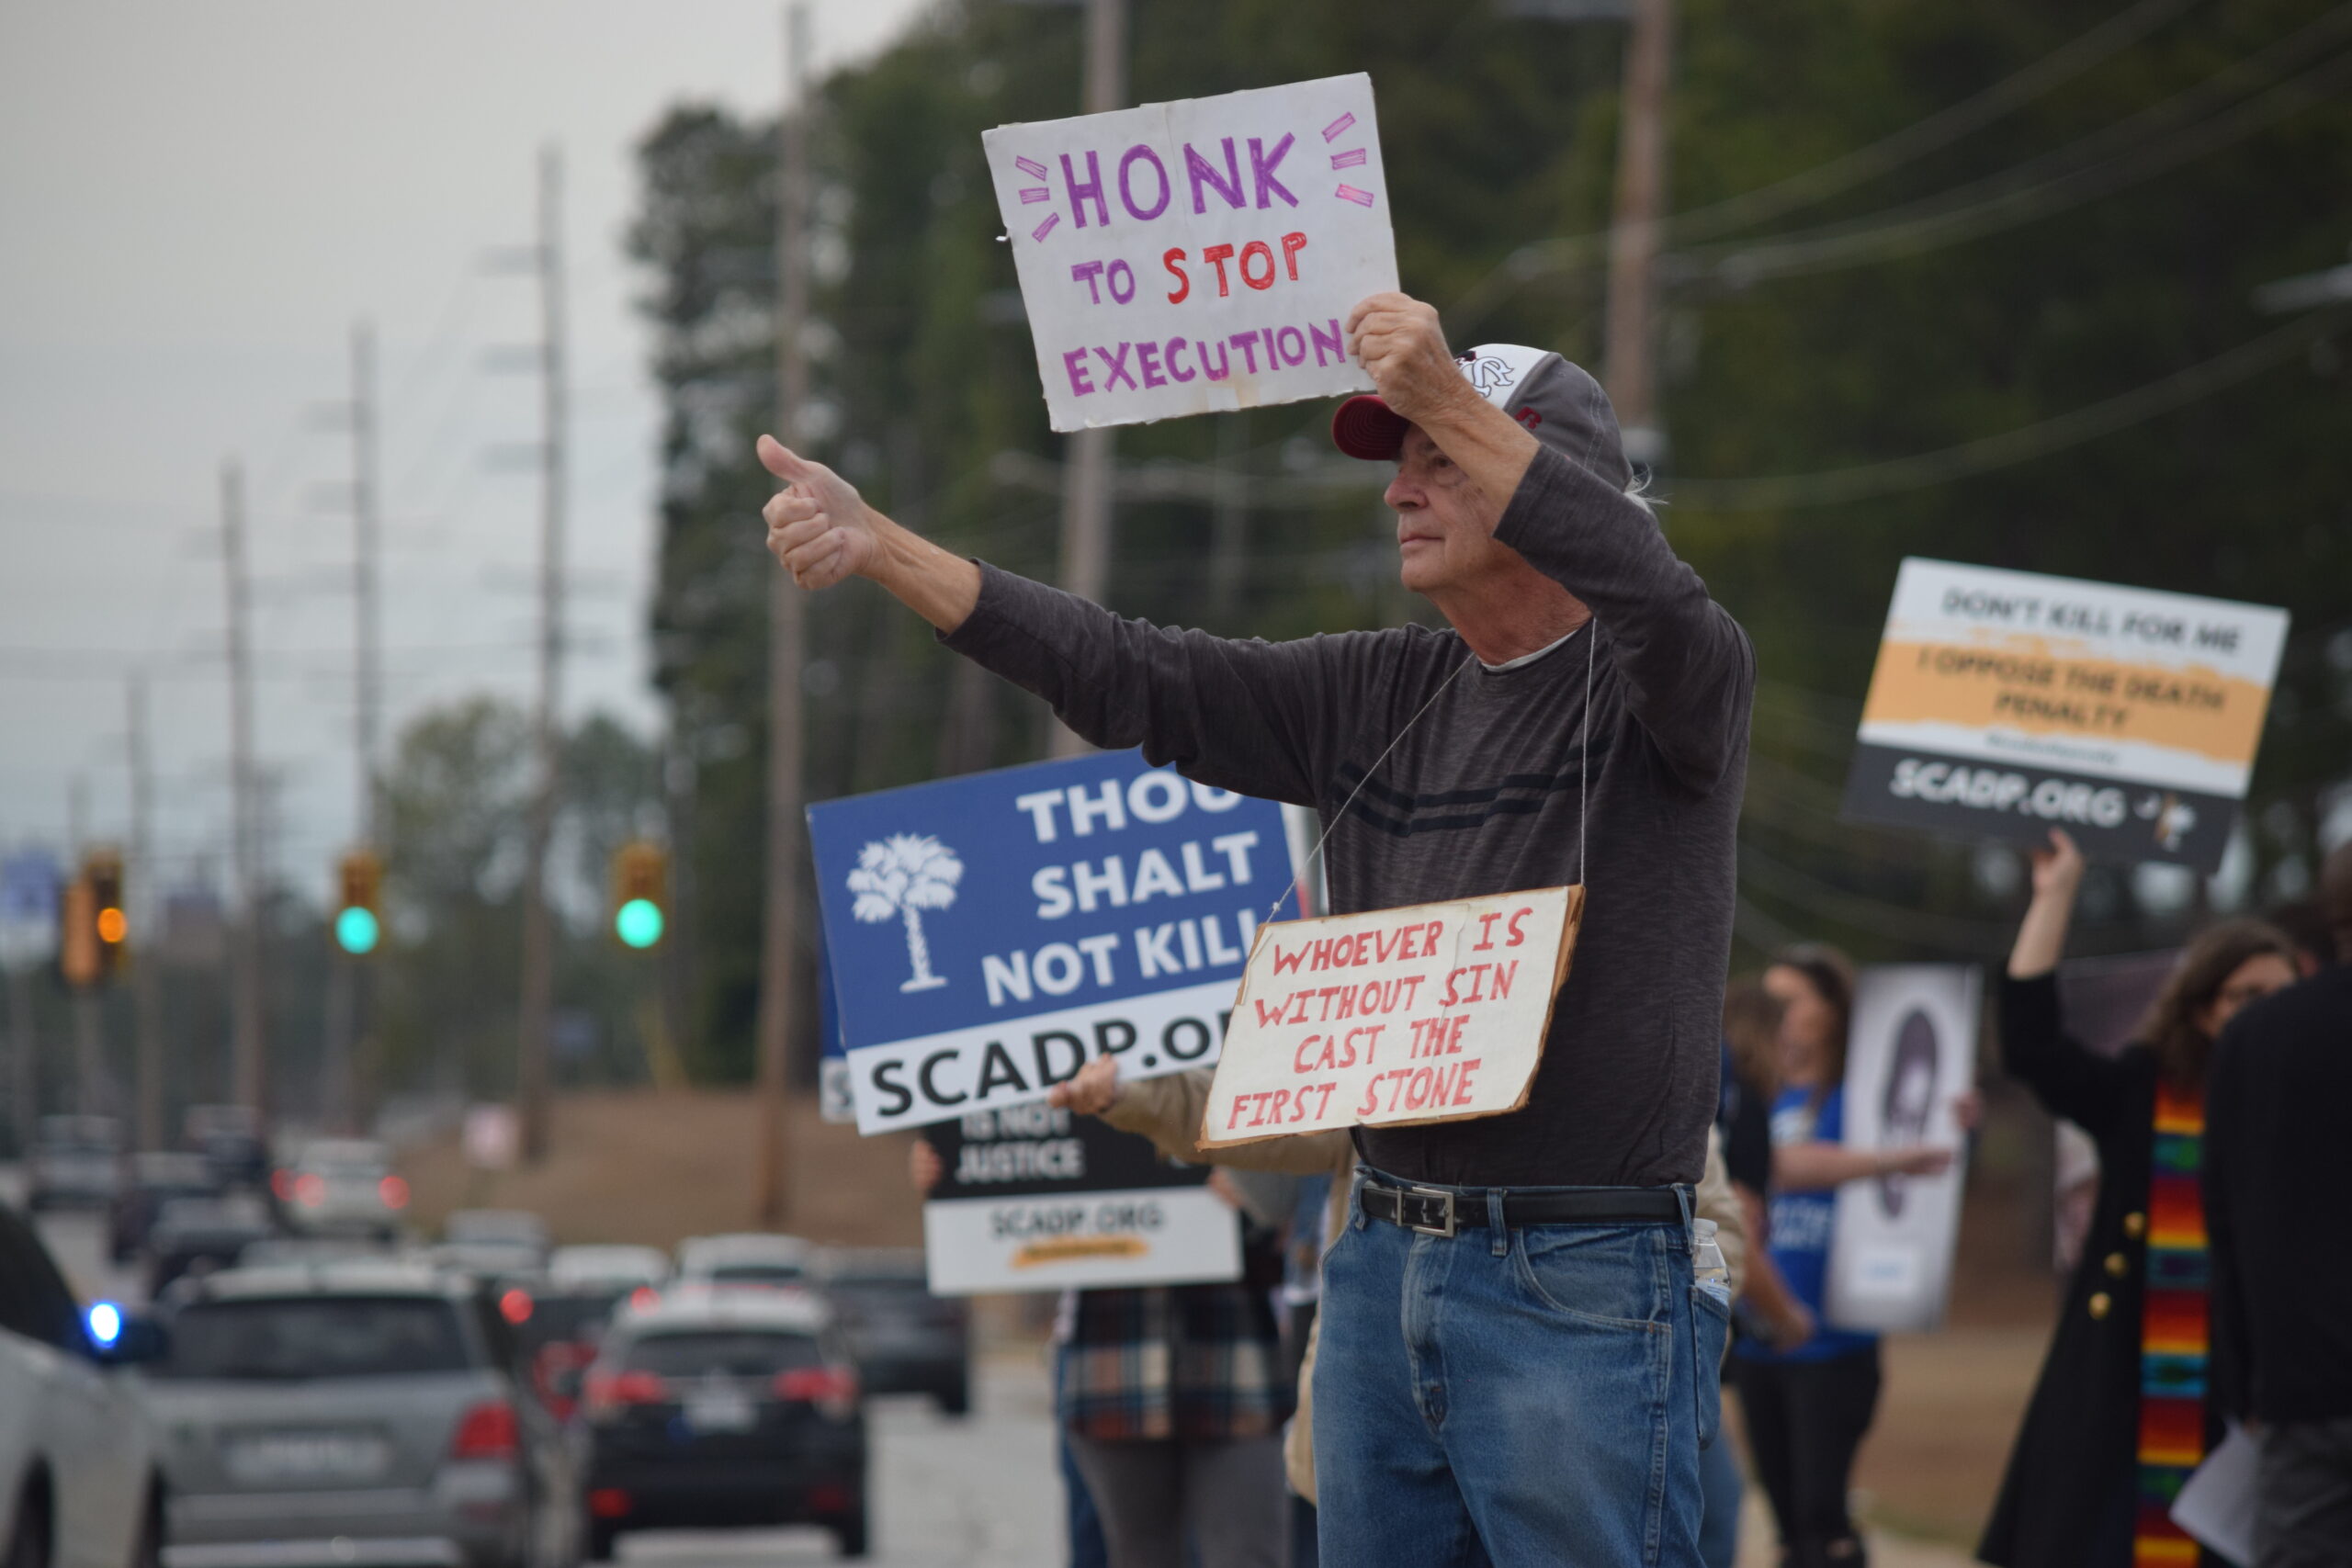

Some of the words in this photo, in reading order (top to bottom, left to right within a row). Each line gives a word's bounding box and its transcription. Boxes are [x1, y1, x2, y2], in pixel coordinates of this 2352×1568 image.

[1059, 131, 1299, 229] HONK
[1070, 258, 1136, 305] TO
[1162, 231, 1307, 304] STOP
[1063, 319, 1346, 397] EXECUTION
[1942, 587, 2041, 624] DON'T
[2046, 602, 2110, 636] KILL
[2121, 612, 2188, 642] FOR
[2192, 622, 2242, 654] ME
[1933, 649, 2054, 687] OPPOSE
[2064, 667, 2117, 694] THE
[2124, 673, 2225, 711] DEATH
[1995, 693, 2130, 731] PENALTY
[1888, 759, 2126, 828] SCADP.ORG
[1031, 831, 1259, 919] SHALT
[981, 933, 1119, 1007] NOT
[1273, 920, 1444, 976] WHOEVER
[1473, 907, 1533, 952] IS
[1255, 975, 1425, 1029] WITHOUT
[1439, 959, 1519, 1008] SIN
[871, 1010, 1232, 1117] SCADP.O
[1294, 1024, 1385, 1074] CAST
[1409, 1014, 1470, 1059] THE
[1227, 1082, 1337, 1131] FIRST
[1357, 1058, 1481, 1117] STONE
[955, 1137, 1087, 1184] JUSTICE
[990, 1201, 1165, 1242] SCADP.ORG
